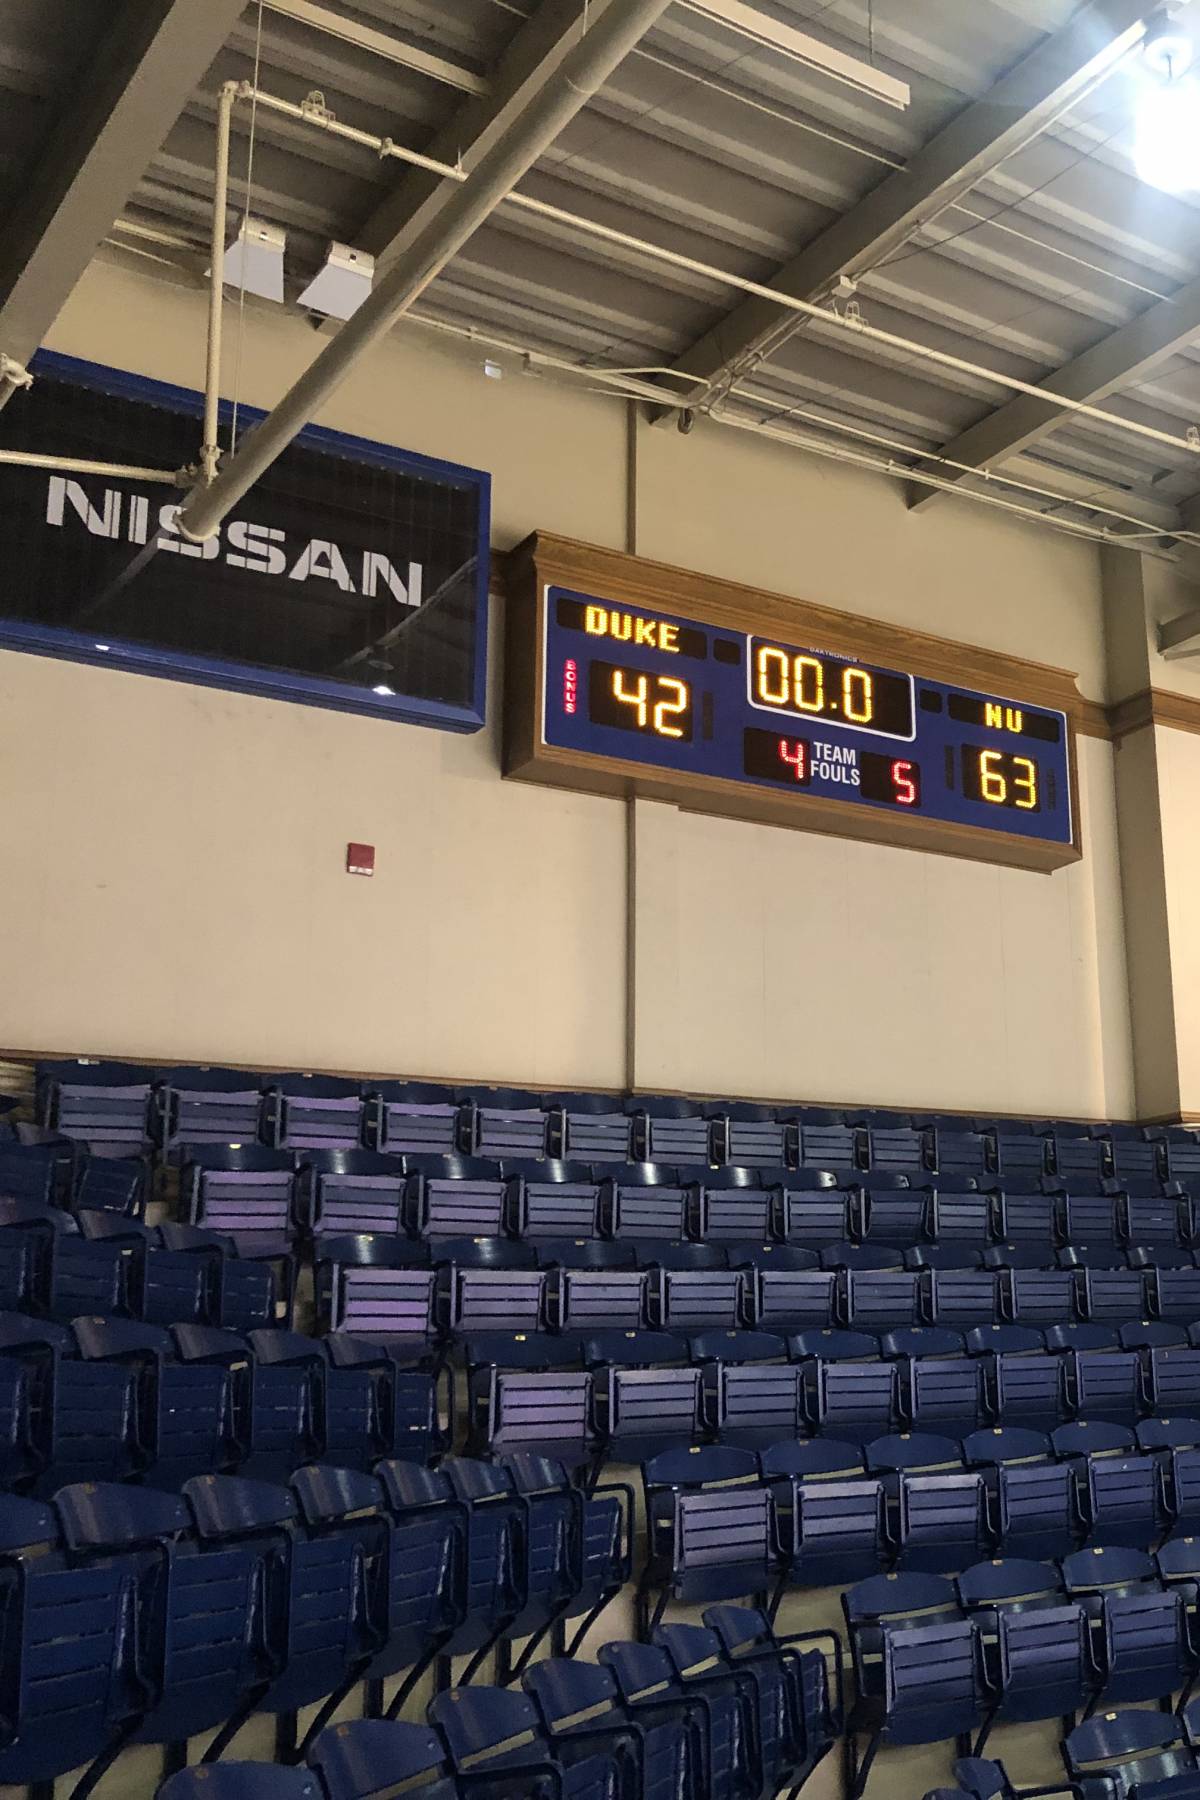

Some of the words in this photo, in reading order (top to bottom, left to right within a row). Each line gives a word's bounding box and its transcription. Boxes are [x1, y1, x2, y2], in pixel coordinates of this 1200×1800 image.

[46, 476, 423, 607] NISSAN
[585, 605, 680, 653] DUKE
[565, 659, 577, 714] BONUS
[613, 670, 687, 737] 42
[759, 647, 873, 723] 00.0
[985, 702, 1022, 733] NU
[780, 739, 804, 779] 4
[810, 760, 861, 787] FOULS
[813, 741, 857, 767] TEAM
[894, 761, 916, 803] 5
[980, 750, 1036, 808] 63
